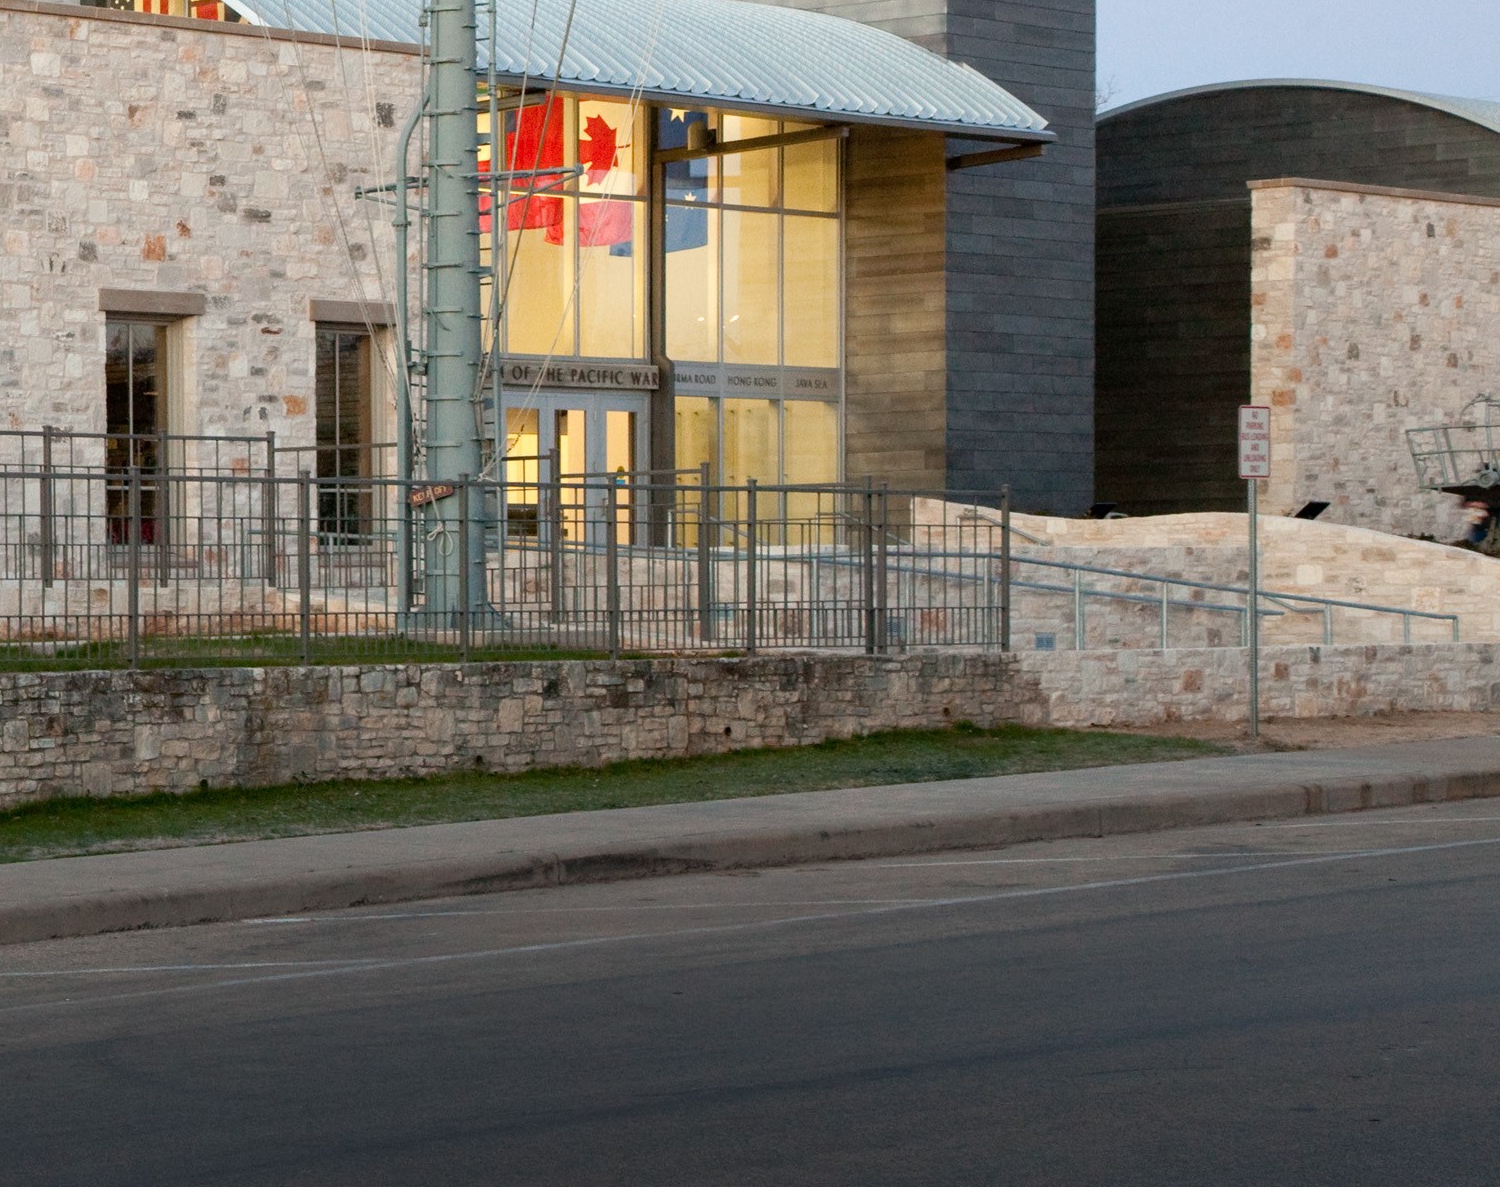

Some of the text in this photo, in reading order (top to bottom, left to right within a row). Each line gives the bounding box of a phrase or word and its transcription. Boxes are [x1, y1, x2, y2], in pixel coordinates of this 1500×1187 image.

[511, 365, 531, 381] OF
[571, 368, 623, 385] PACIFIC
[630, 371, 658, 386] WAR
[694, 374, 716, 385] ROAD
[727, 375, 777, 388] HONG KONG
[795, 378, 828, 390] JAVA SEA
